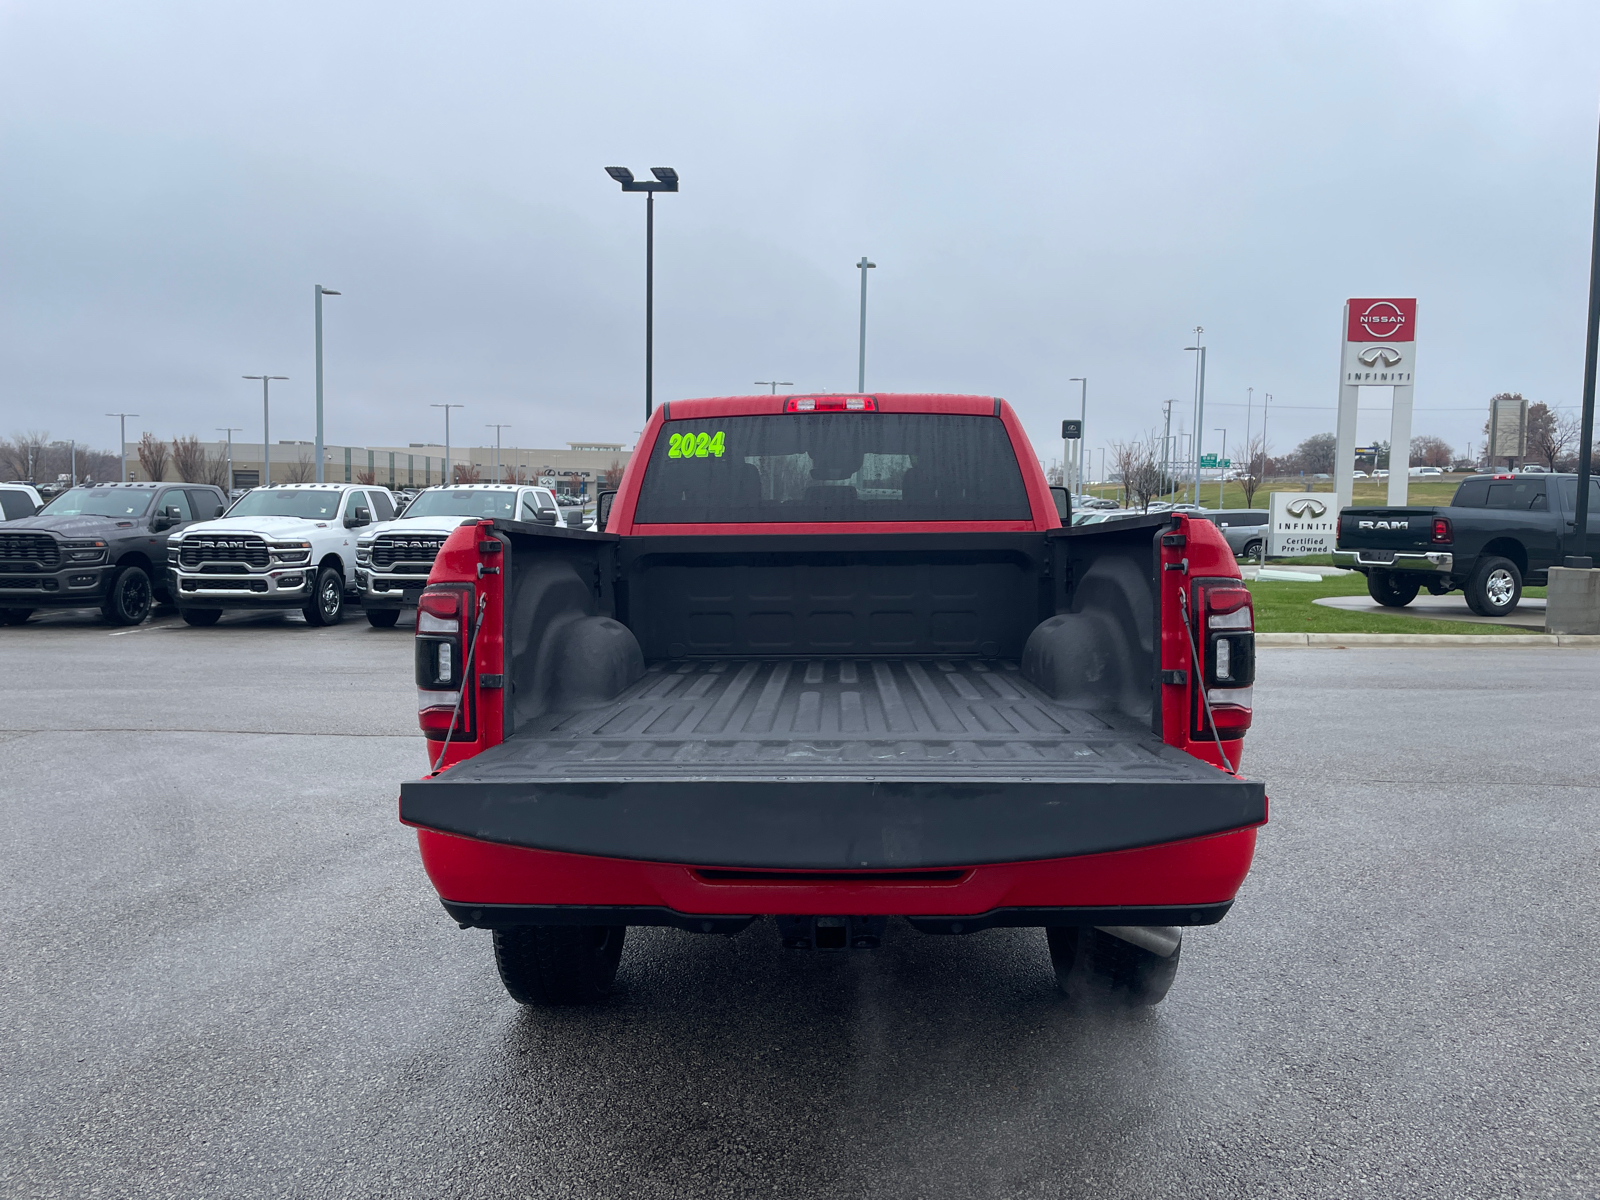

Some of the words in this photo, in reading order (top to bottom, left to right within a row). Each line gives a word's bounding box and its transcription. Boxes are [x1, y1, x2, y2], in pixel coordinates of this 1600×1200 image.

[668, 431, 725, 458] 2024
[1358, 521, 1408, 530] RAM
[1286, 537, 1324, 545] Certified
[1281, 545, 1328, 553] Pre-Owned
